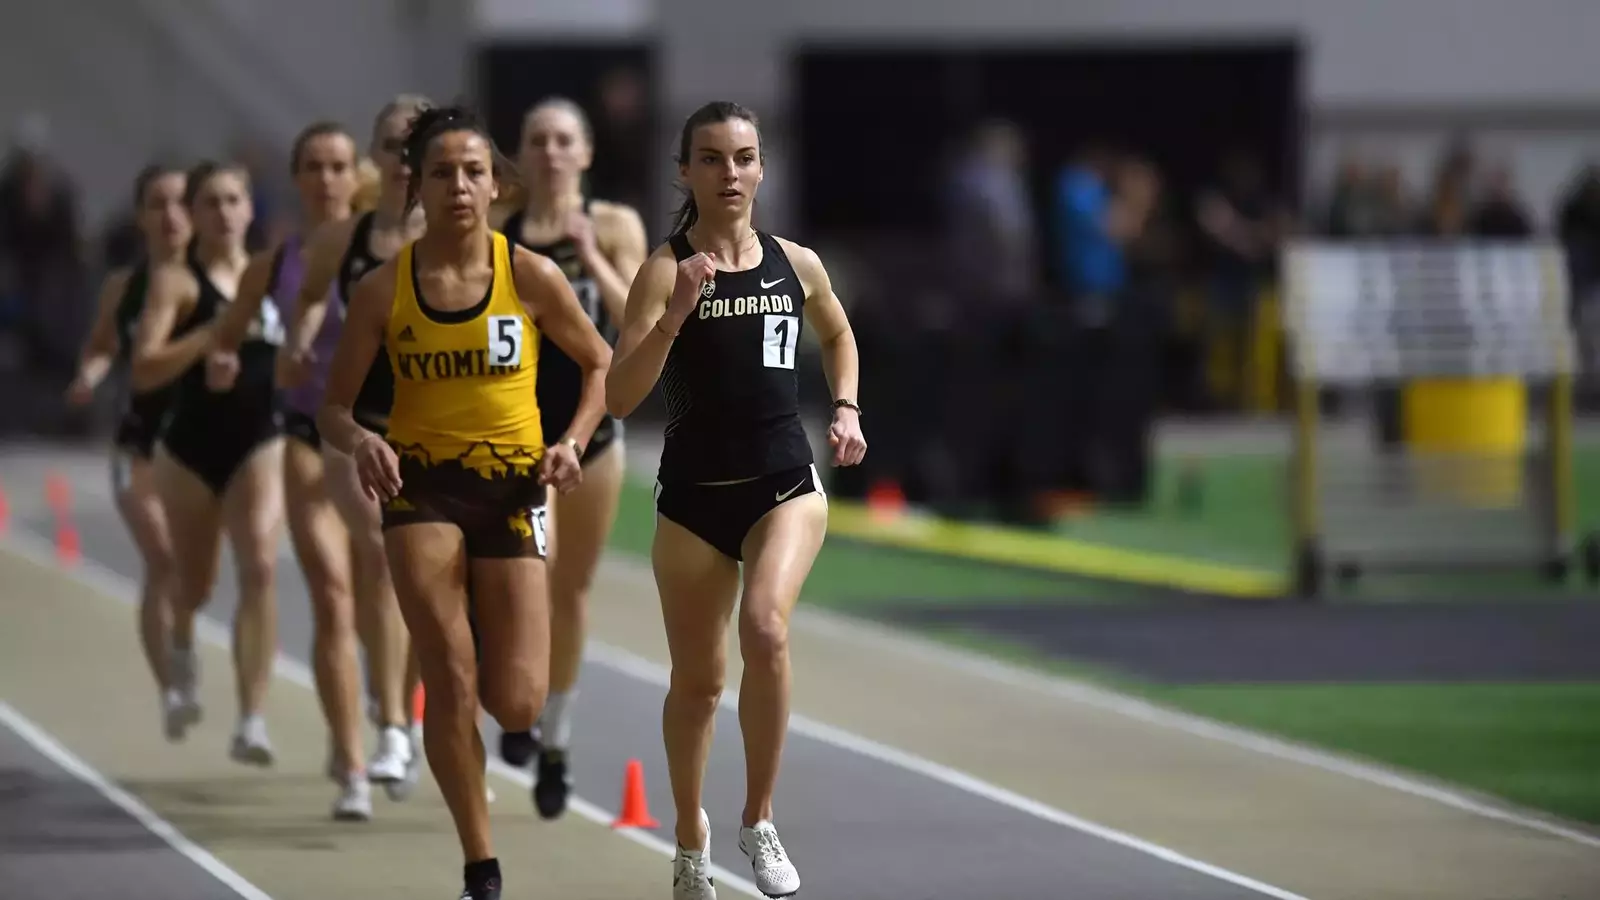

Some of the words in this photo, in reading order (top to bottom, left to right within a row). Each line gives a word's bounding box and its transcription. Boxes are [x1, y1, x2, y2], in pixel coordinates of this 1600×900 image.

[698, 294, 793, 320] COLORADO
[497, 319, 516, 363] 5
[774, 319, 789, 365] 1
